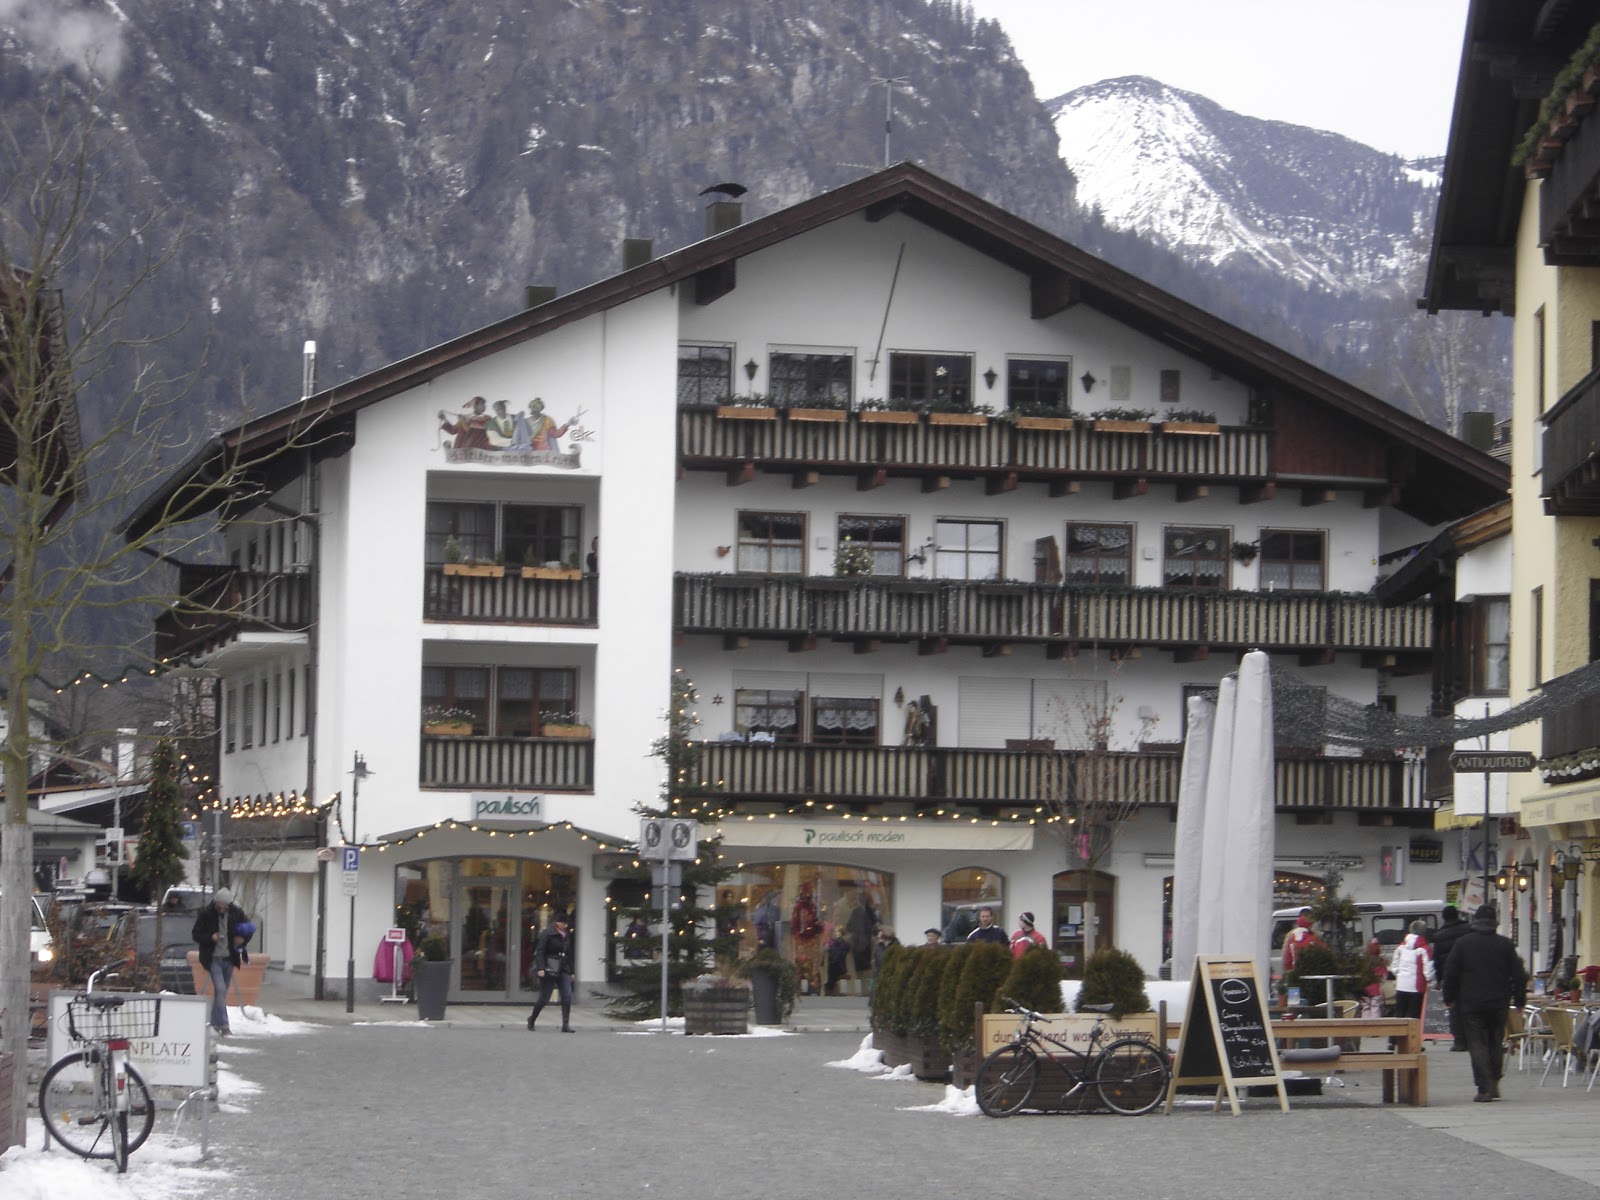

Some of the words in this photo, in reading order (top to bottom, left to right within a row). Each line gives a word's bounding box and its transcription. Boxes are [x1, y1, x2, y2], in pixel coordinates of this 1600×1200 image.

[992, 1029, 1068, 1043] durehend
[1072, 1031, 1110, 1042] wae
[68, 1038, 192, 1057] MNPLATZ
